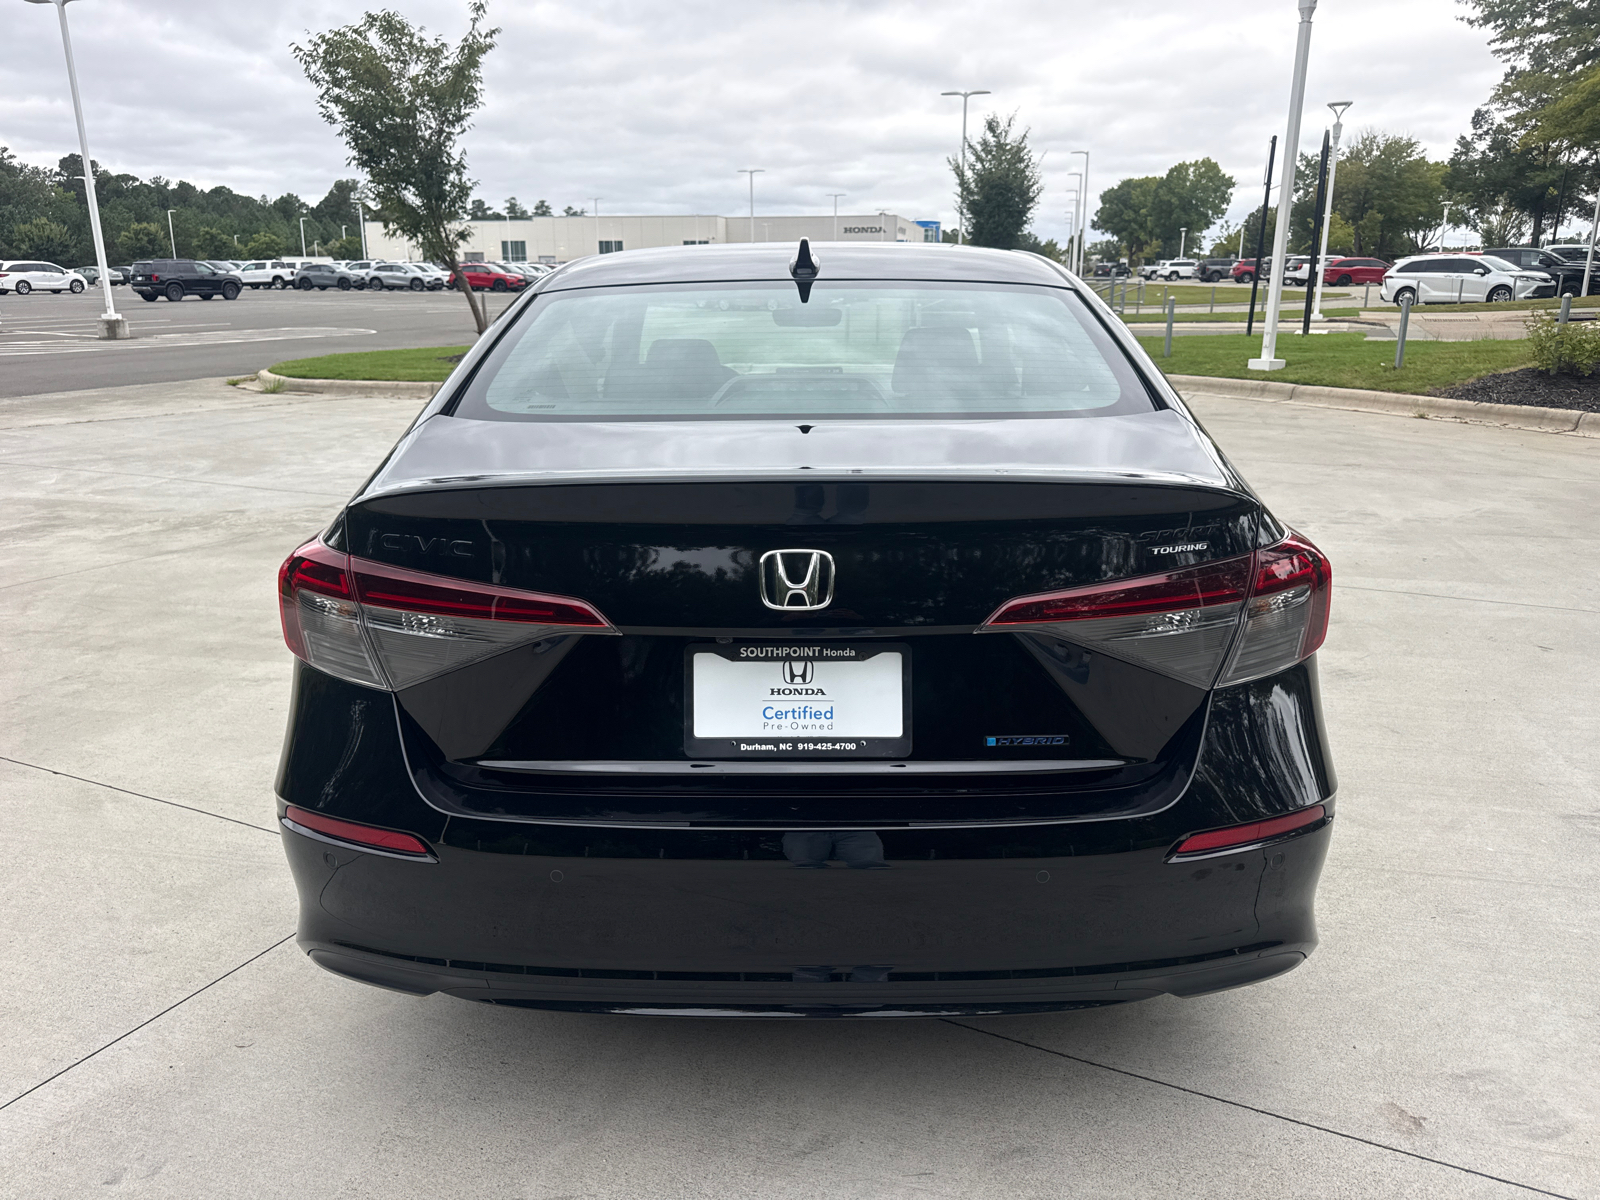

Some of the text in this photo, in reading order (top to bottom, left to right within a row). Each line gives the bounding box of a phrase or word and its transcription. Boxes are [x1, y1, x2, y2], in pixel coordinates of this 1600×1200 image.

[1136, 524, 1221, 542] SPORT
[381, 533, 475, 557] CIVIC
[1152, 543, 1208, 555] TOURING
[740, 646, 856, 657] SOUTHPOINT Honda
[769, 688, 827, 696] HONDA
[762, 705, 834, 720] Certified
[763, 722, 834, 730] Pre-Owned
[997, 737, 1065, 745] HYBRID
[740, 743, 777, 752] Durham,
[797, 742, 856, 751] 919-425-4700
